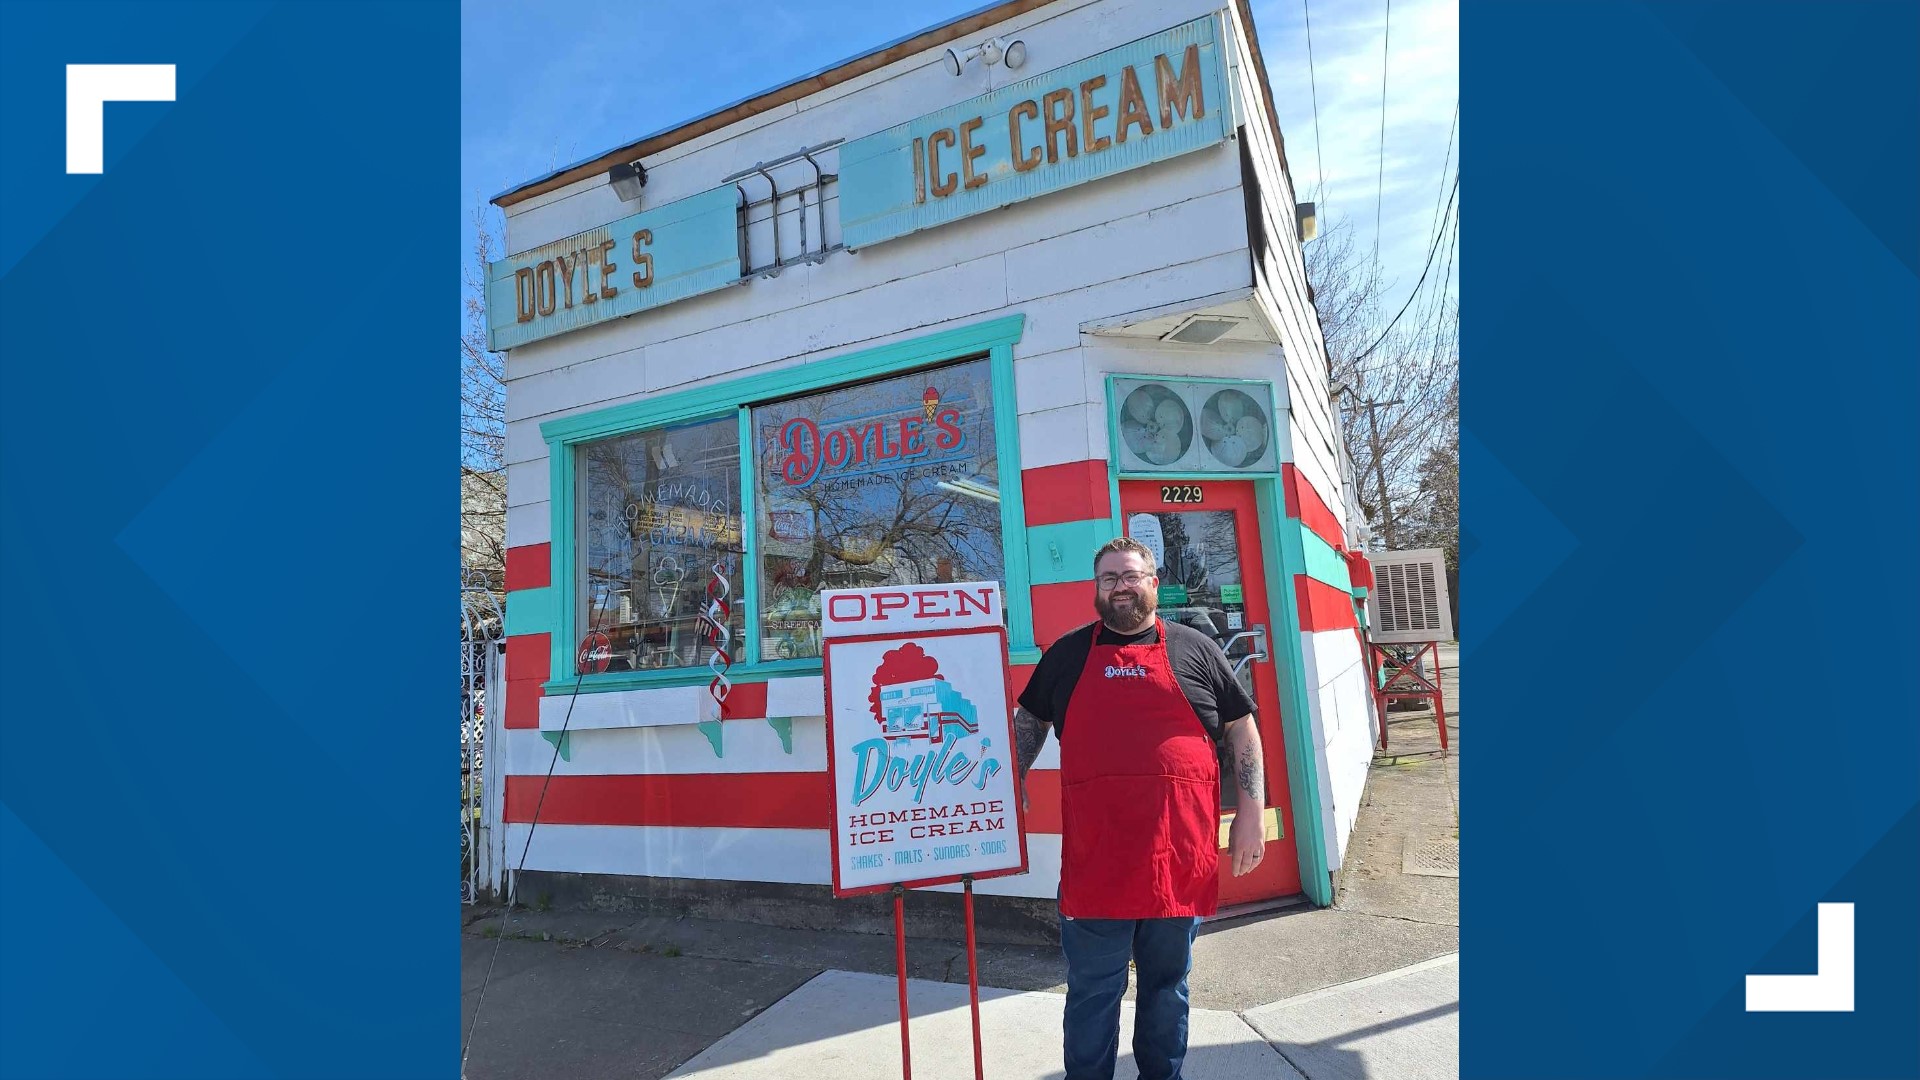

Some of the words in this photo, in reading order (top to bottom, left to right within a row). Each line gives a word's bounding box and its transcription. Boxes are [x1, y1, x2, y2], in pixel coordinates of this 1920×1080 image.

[912, 116, 988, 204] ICE
[1009, 43, 1205, 172] CREAM
[516, 239, 617, 323] DOYLE
[632, 229, 654, 288] S
[824, 473, 892, 492] HOMEMADE
[896, 467, 915, 482] ICE
[922, 462, 968, 479] CREAM
[613, 483, 725, 535] HOMEMADE
[1162, 486, 1202, 503] 2229
[829, 589, 994, 623] OPEN
[851, 732, 1002, 807] Doyle's
[849, 800, 1004, 828] HOMEMADE
[850, 830, 894, 846] ICE
[910, 817, 1005, 839] CREAM
[851, 853, 884, 870] SHAKES
[894, 849, 923, 865] MALTS
[933, 843, 971, 861] SUNDAES
[981, 839, 1007, 855] SODAS
